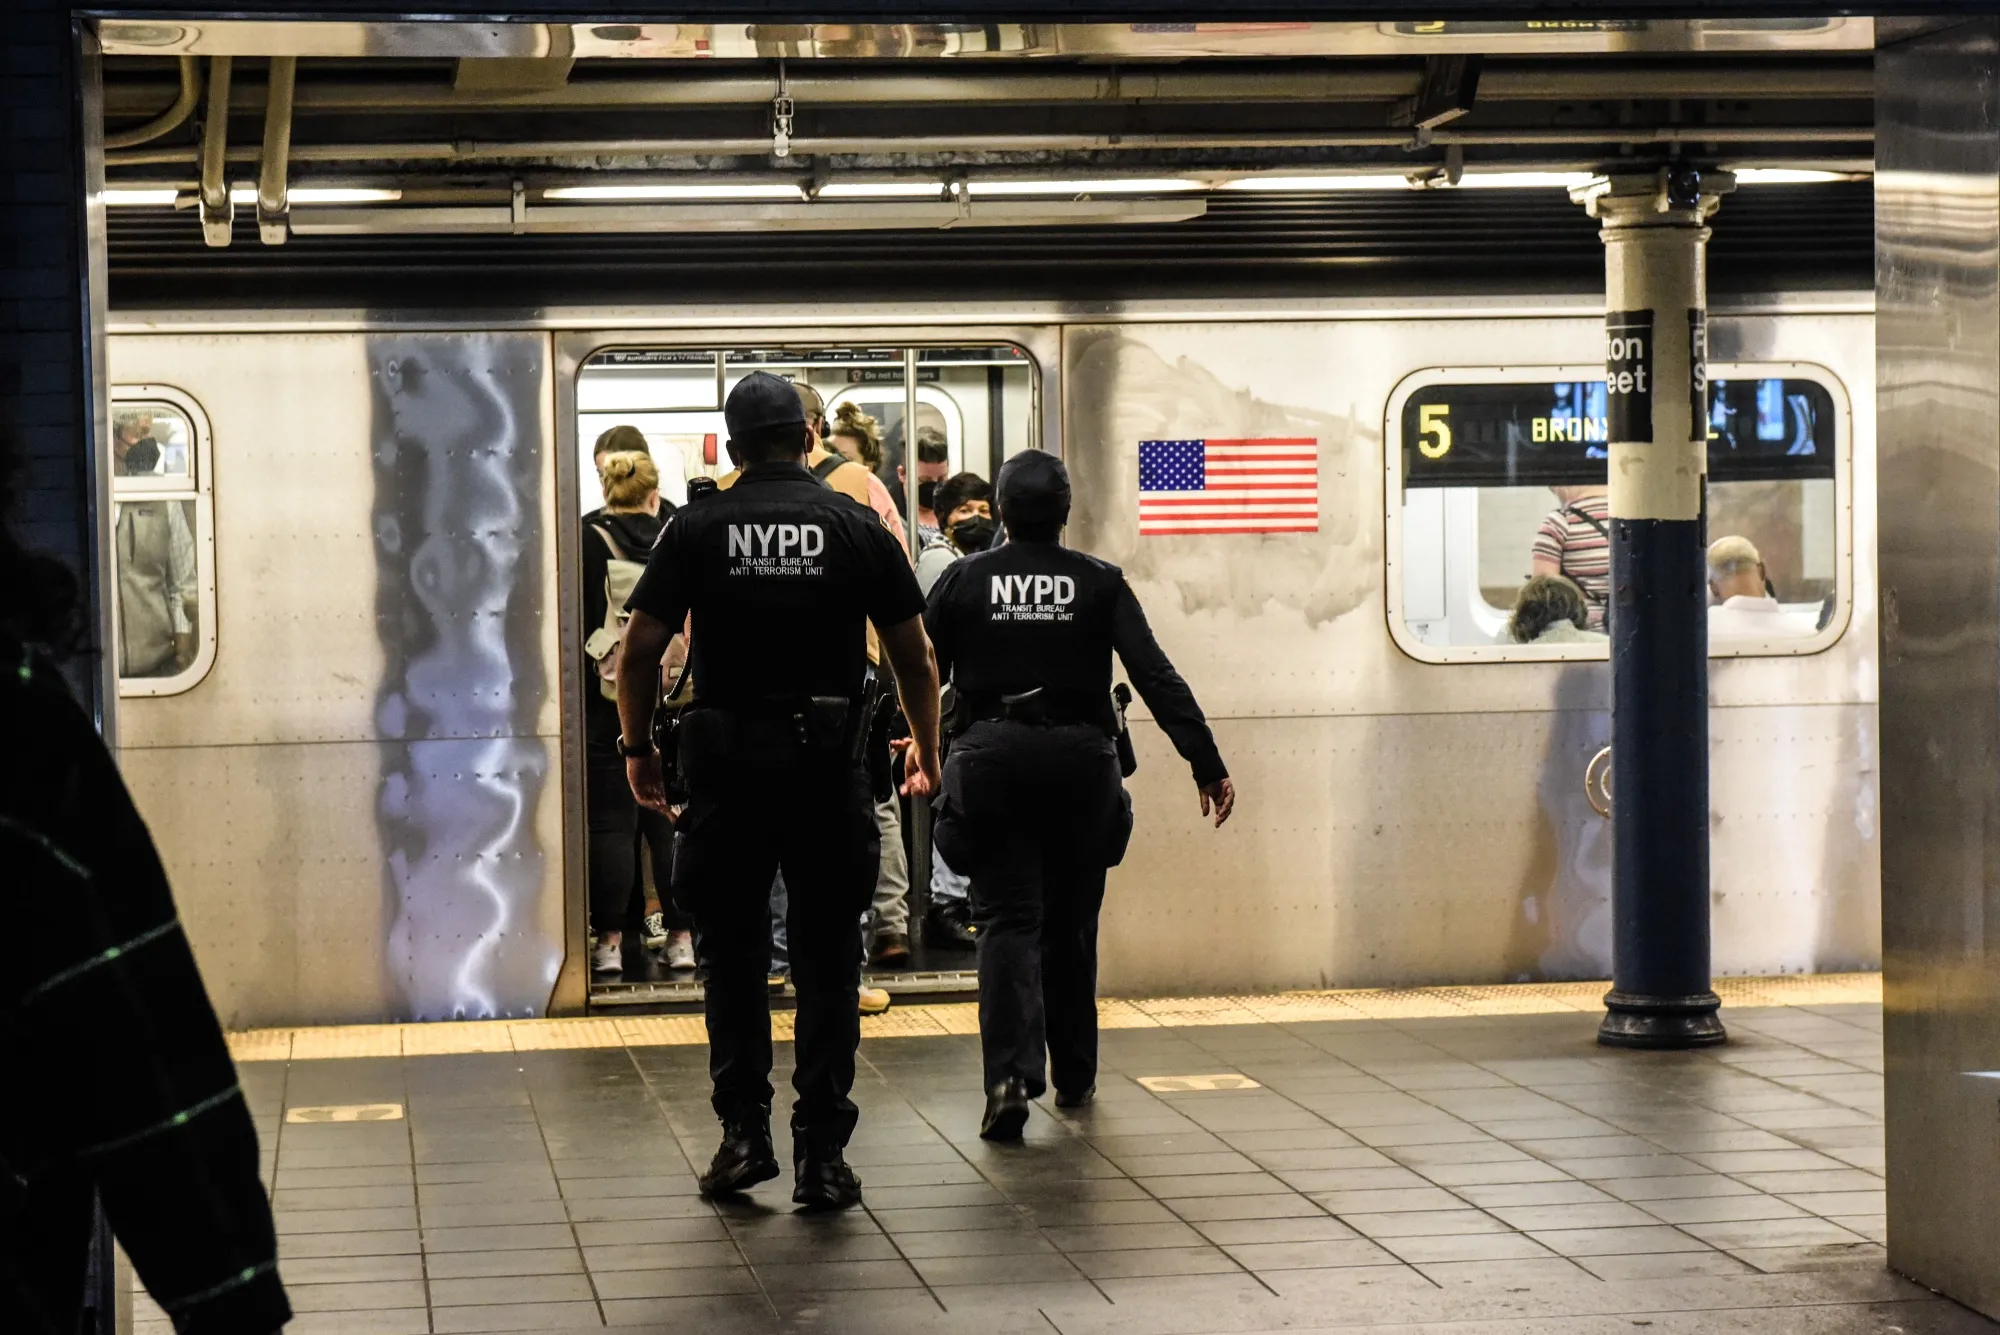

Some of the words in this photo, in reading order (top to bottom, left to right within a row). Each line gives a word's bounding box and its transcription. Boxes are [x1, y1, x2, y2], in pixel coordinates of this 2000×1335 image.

[865, 371, 877, 380] Do
[1418, 404, 1451, 459] 5
[728, 524, 824, 557] NYPD
[740, 557, 777, 566] TRANSIT
[780, 557, 813, 566] BUREAU
[729, 566, 749, 576] ANTI
[753, 566, 801, 576] TERRORISM
[805, 566, 824, 576] UNIT
[991, 574, 1075, 605] NYPD
[1001, 604, 1033, 613] TRANSIT
[1036, 604, 1065, 613] BUREAU
[991, 612, 1010, 621] ANTI
[1013, 612, 1054, 621] TERRORISM
[1057, 612, 1074, 621] UNIT
